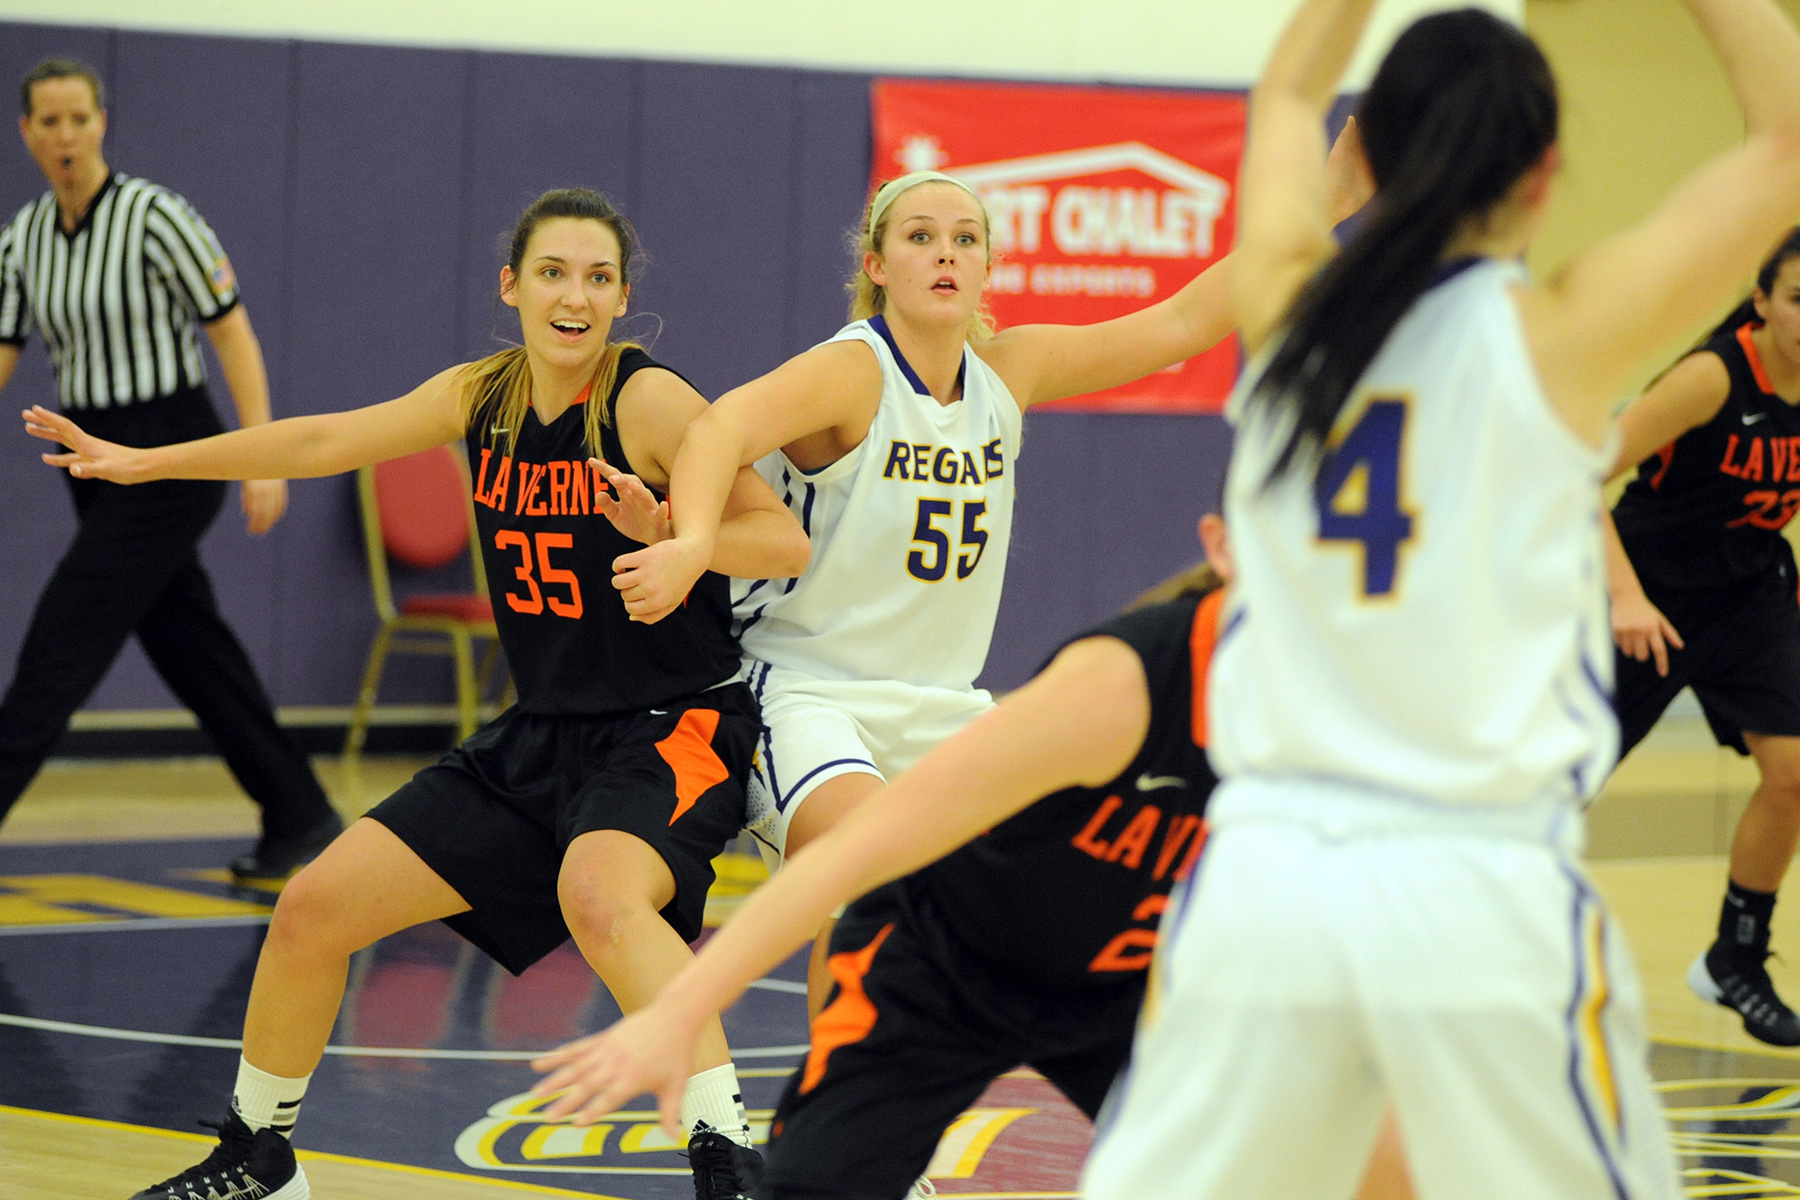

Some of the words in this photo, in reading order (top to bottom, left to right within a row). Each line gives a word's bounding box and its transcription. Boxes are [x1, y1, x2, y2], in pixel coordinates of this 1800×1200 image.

[1051, 184, 1221, 259] CHALET
[474, 448, 511, 512] LA
[1719, 433, 1764, 482] LA
[1312, 394, 1420, 599] 4
[494, 529, 583, 619] 35
[905, 496, 990, 584] 55
[1071, 794, 1162, 870] LA
